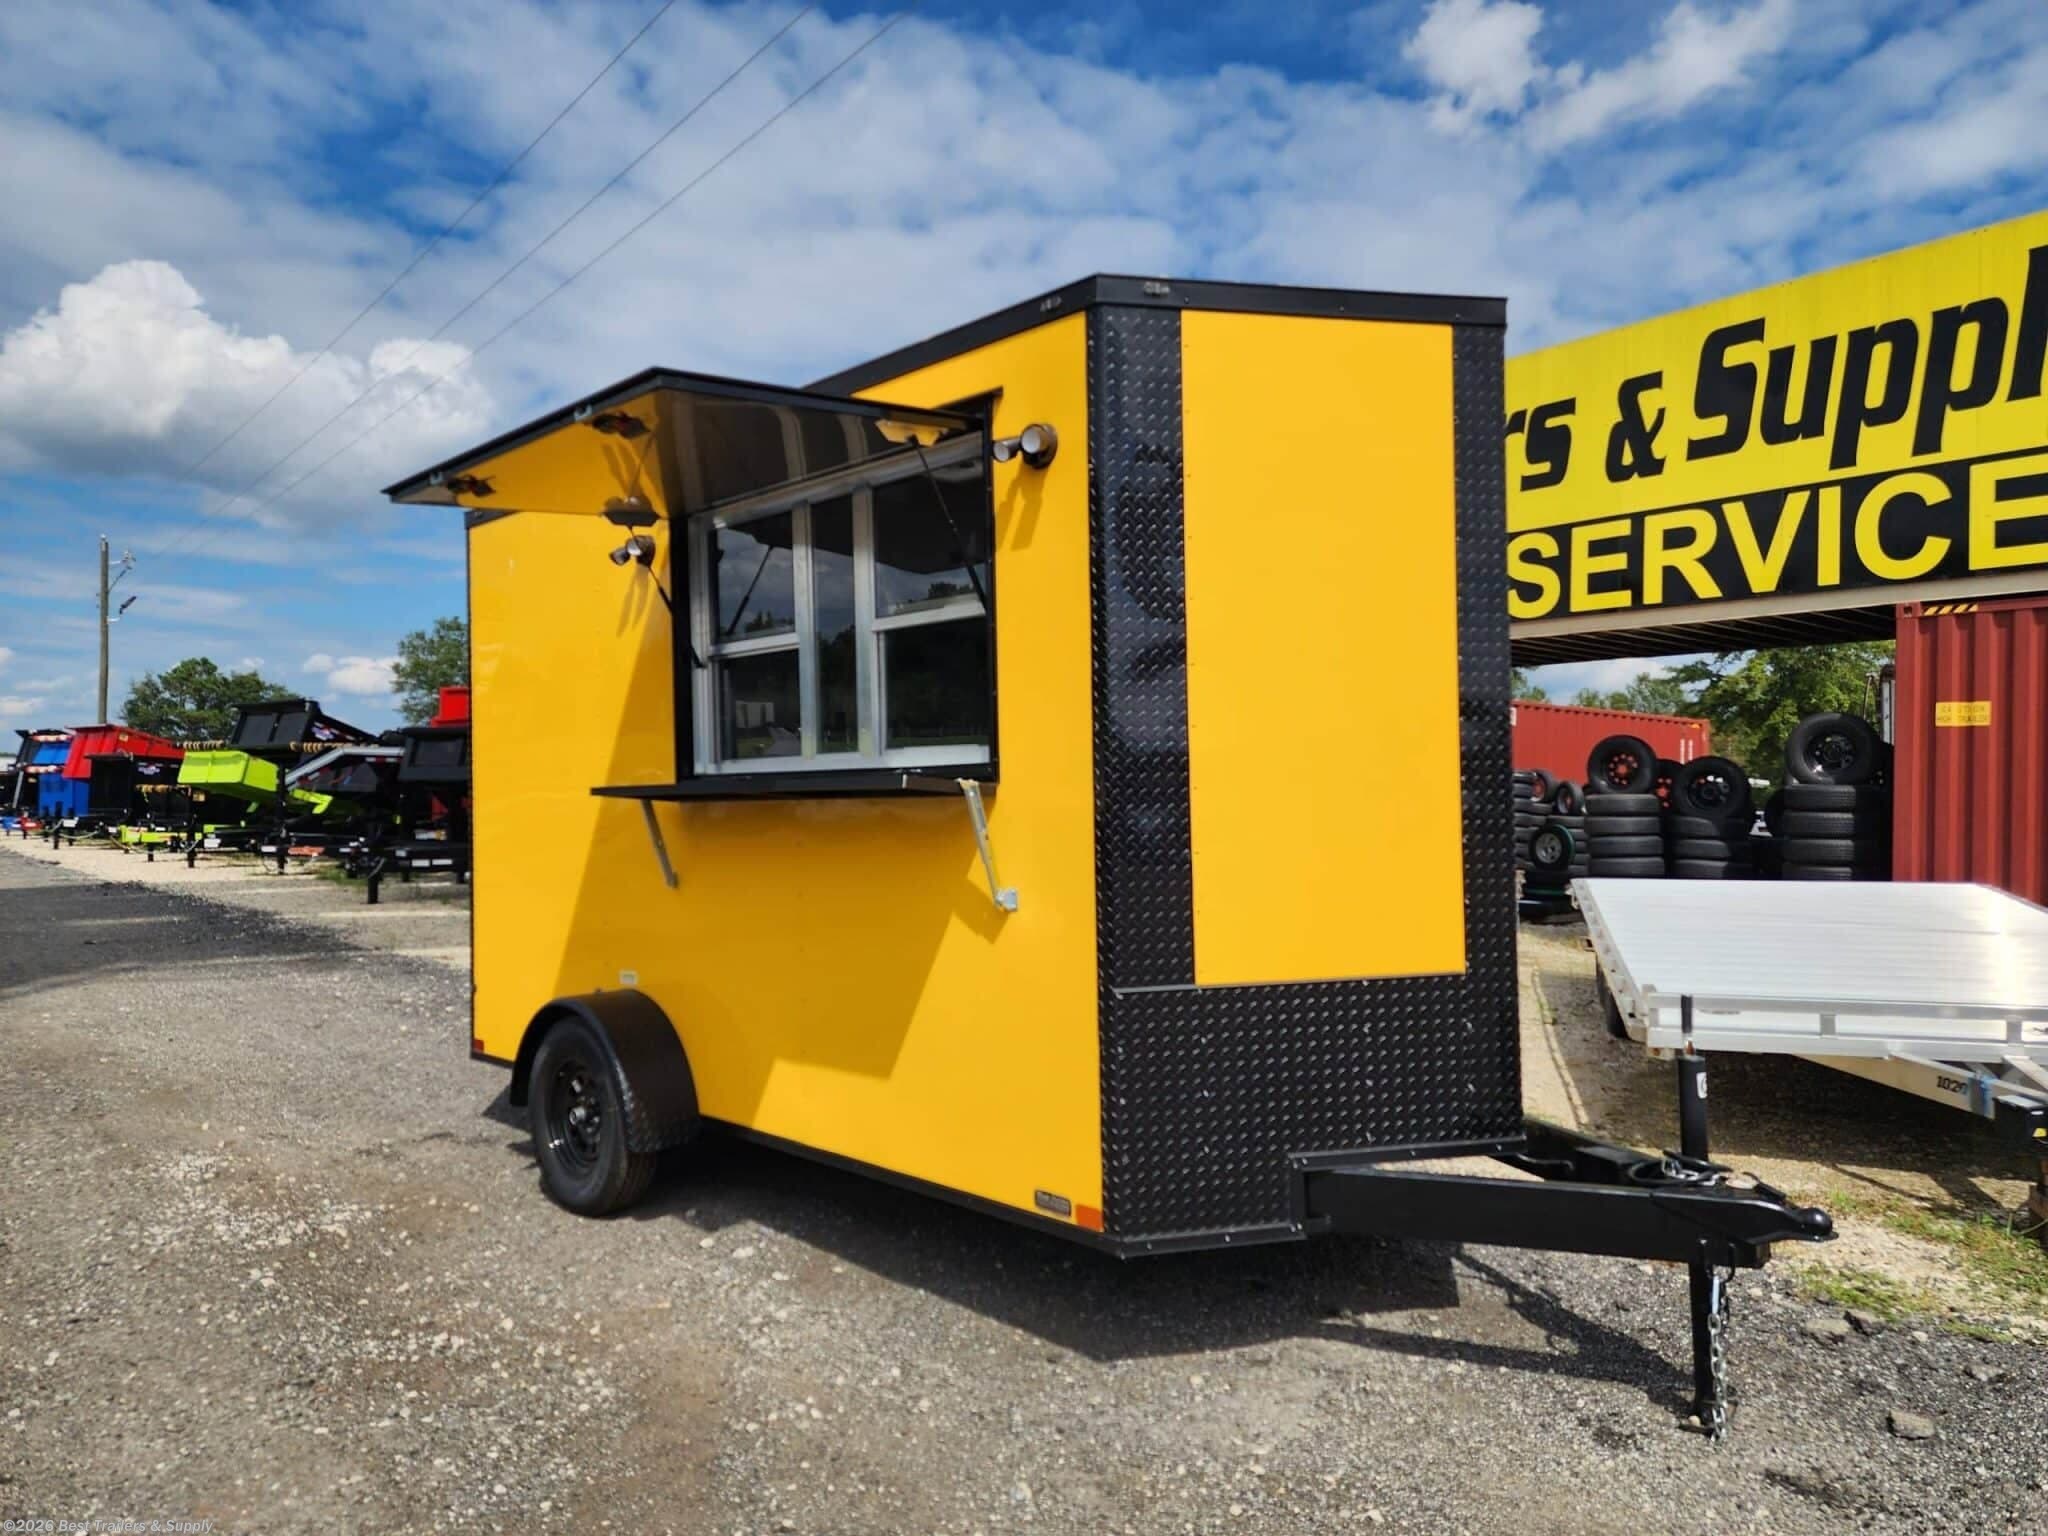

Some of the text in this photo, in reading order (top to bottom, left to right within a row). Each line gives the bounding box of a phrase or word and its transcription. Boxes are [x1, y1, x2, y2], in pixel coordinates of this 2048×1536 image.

[1605, 370, 1667, 483] &
[1686, 244, 2048, 472] Suppl
[1507, 453, 2048, 620] SERVICE
